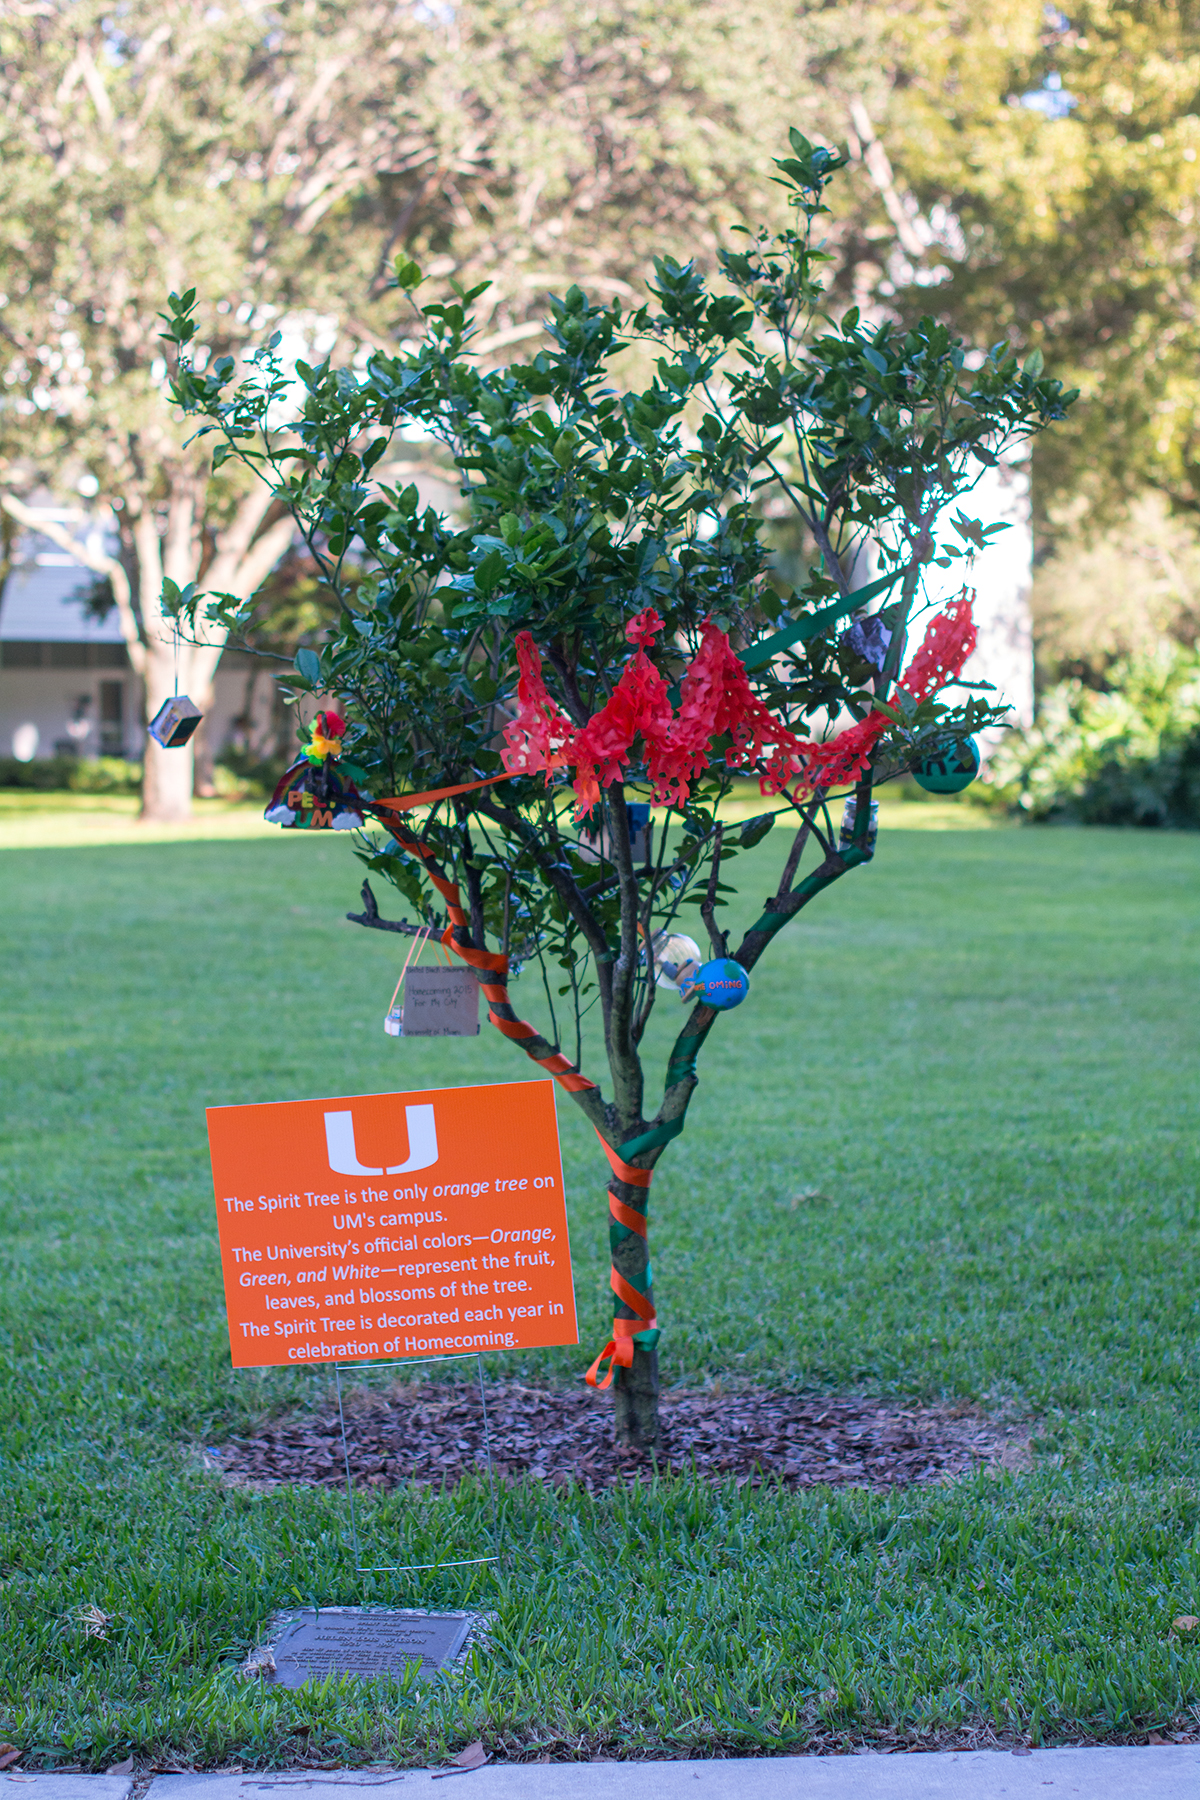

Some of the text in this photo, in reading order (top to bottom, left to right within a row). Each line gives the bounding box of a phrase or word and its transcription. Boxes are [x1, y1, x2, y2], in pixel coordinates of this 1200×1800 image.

[295, 809, 334, 829] UM
[408, 985, 473, 997] Homecoming 2015
[323, 1103, 439, 1176] U
[223, 1175, 554, 1213] The Spirit Tree is the only orange tree on
[332, 1210, 447, 1229] UM's campus.
[231, 1246, 262, 1262] The
[266, 1238, 359, 1260] University’s
[363, 1234, 418, 1253] official
[238, 1271, 291, 1287] Green,
[296, 1265, 327, 1283] and
[481, 1253, 509, 1269] the
[513, 1249, 555, 1266] fruit,
[264, 1279, 532, 1309] leaves, and blossoms of the tree.
[238, 1300, 563, 1338] The Spirit Tree is decorated each year in
[287, 1329, 519, 1359] celebration of Homecoming.
